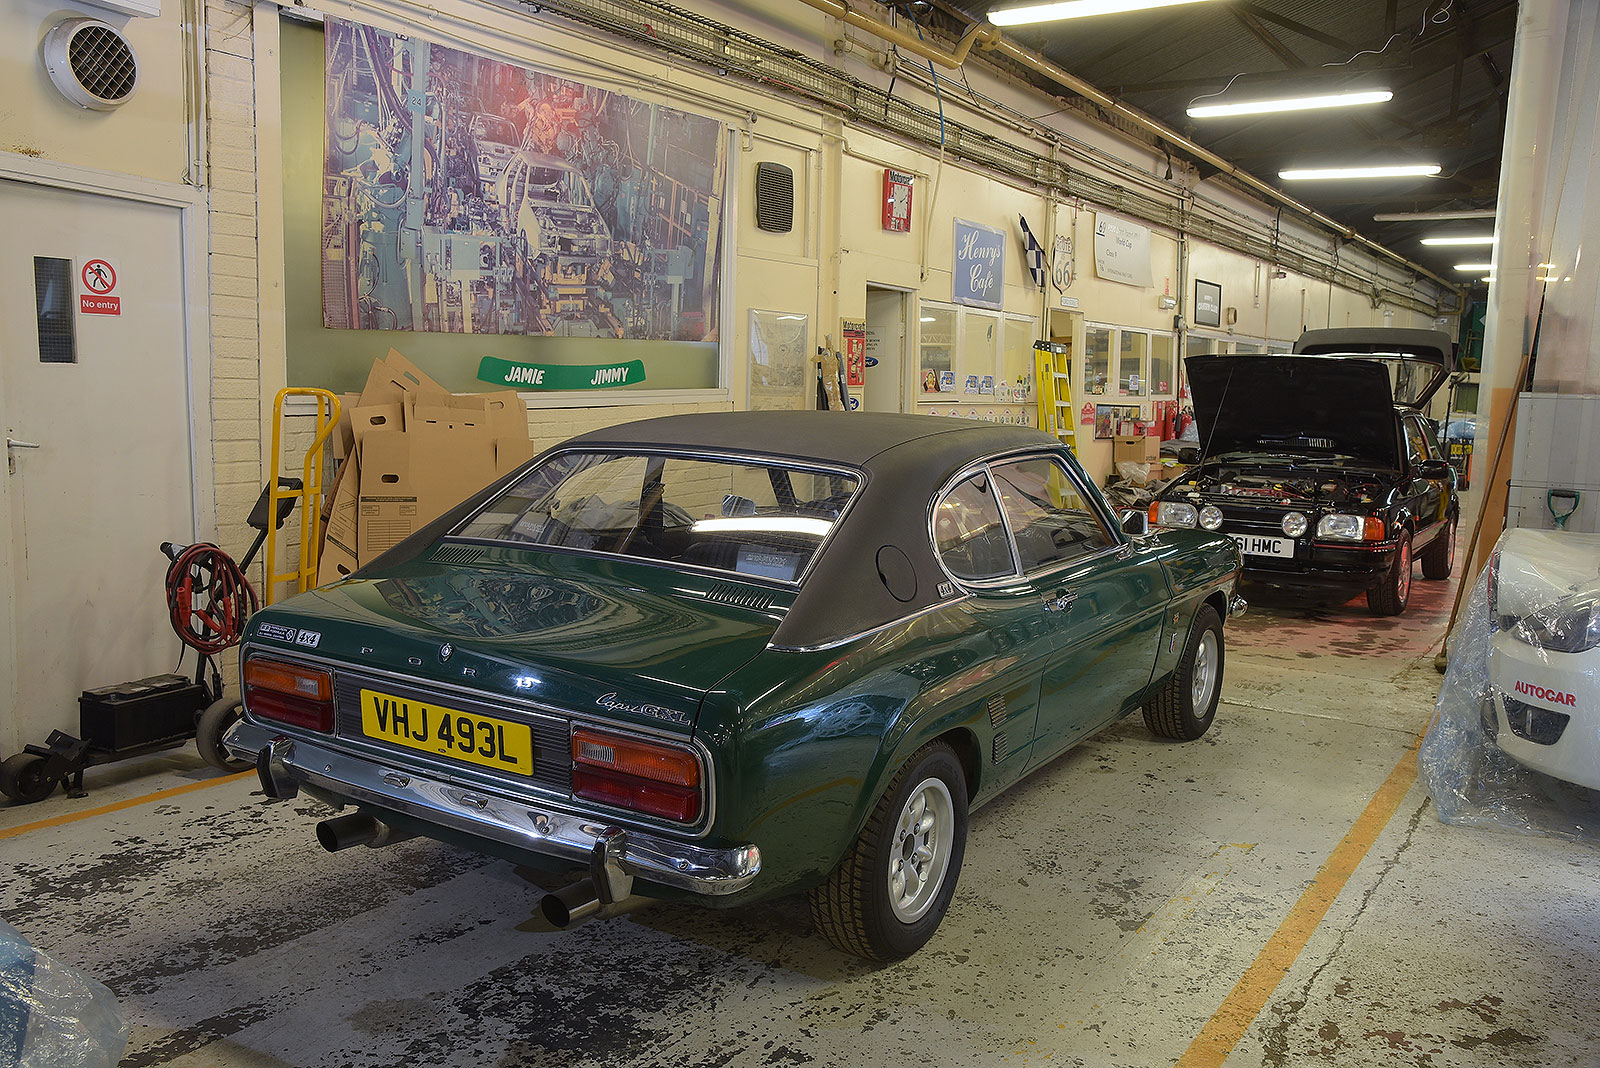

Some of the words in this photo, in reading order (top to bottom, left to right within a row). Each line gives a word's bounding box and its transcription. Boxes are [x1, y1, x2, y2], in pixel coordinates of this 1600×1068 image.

[411, 95, 423, 107] 24
[1056, 240, 1071, 252] ROUTE
[969, 263, 994, 297] Café
[1056, 260, 1071, 287] 66
[82, 300, 95, 308] No
[96, 301, 119, 312] entry
[504, 366, 546, 385] JAMIE
[590, 367, 629, 386] JIMMY
[1251, 538, 1282, 554] HMC
[298, 632, 317, 645] 4x4
[1514, 680, 1577, 708] AUTOCAR
[596, 692, 641, 713] Capri
[641, 704, 691, 725] GXL
[373, 696, 428, 743] VHJ
[437, 713, 518, 765] 493L
